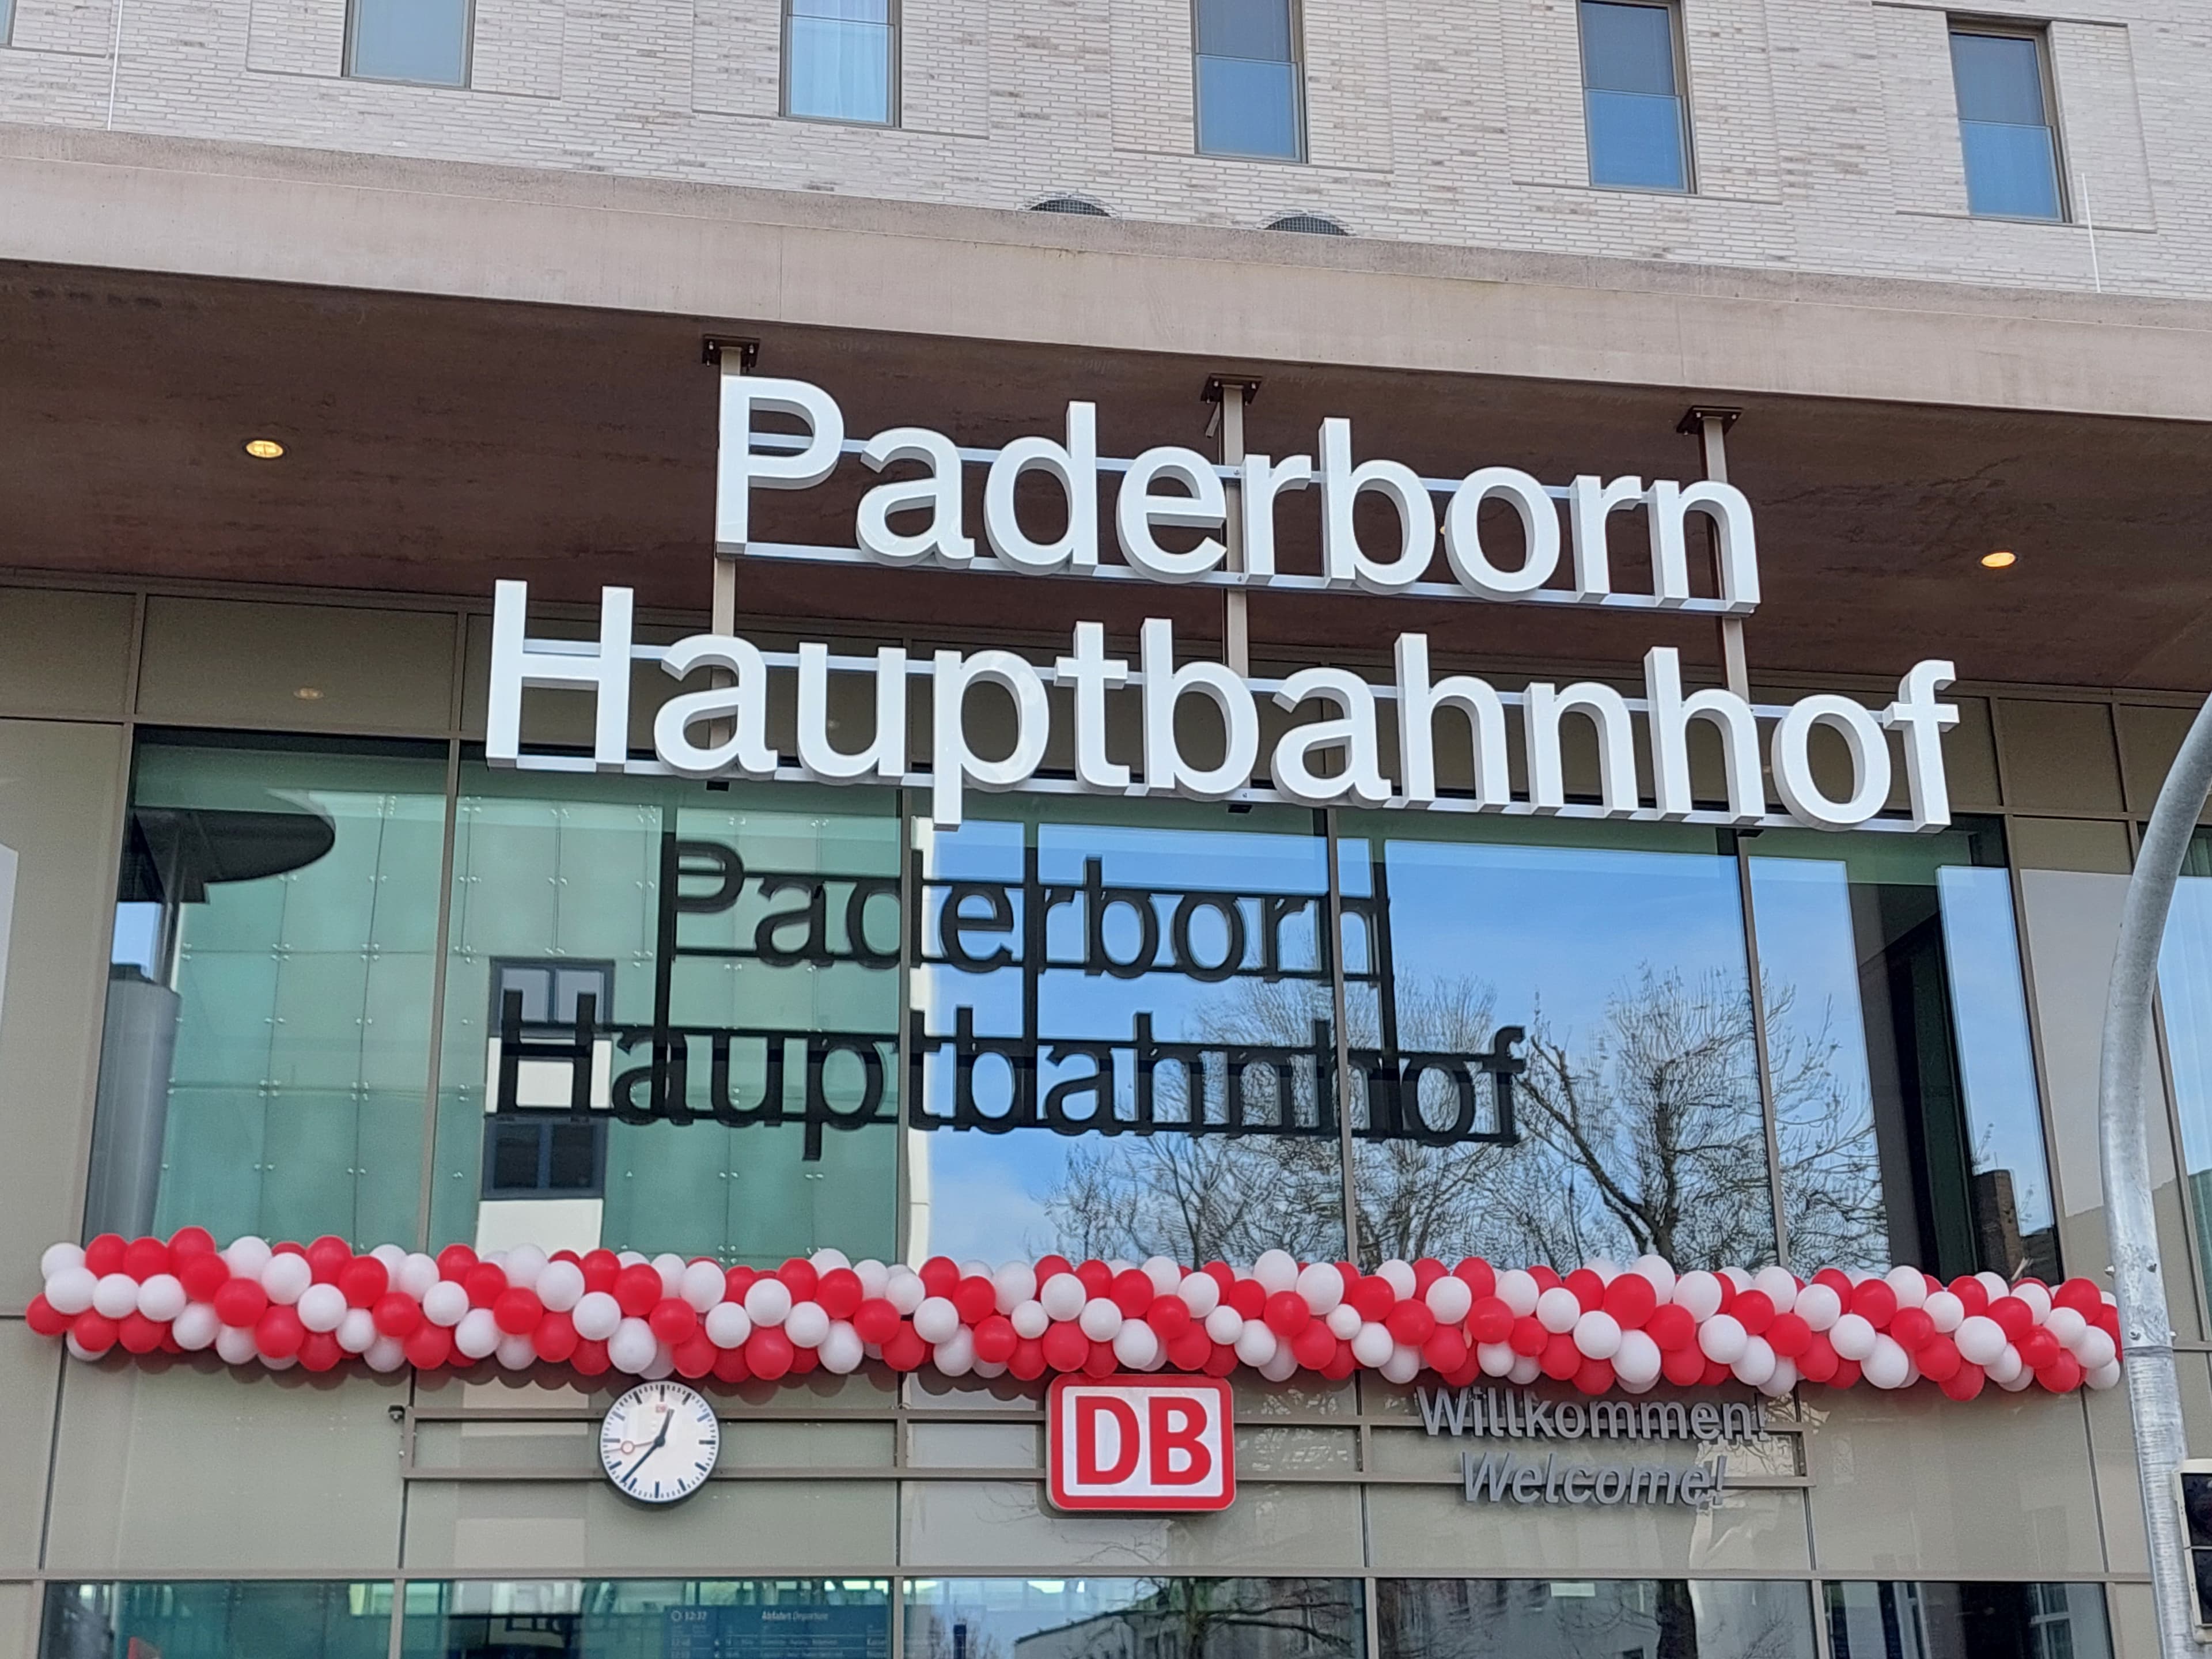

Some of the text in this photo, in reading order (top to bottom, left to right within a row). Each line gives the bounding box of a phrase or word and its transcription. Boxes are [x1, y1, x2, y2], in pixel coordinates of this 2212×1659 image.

[716, 374, 1762, 615] Paderborn
[486, 578, 1960, 834] Hauptbahnhof
[673, 840, 1389, 984] Paderborn
[497, 988, 1527, 1161] Hauptbahnhof
[1075, 1396, 1211, 1485] DB
[1415, 1387, 1768, 1441] Willkommen!
[1461, 1452, 1727, 1506] Welcome!
